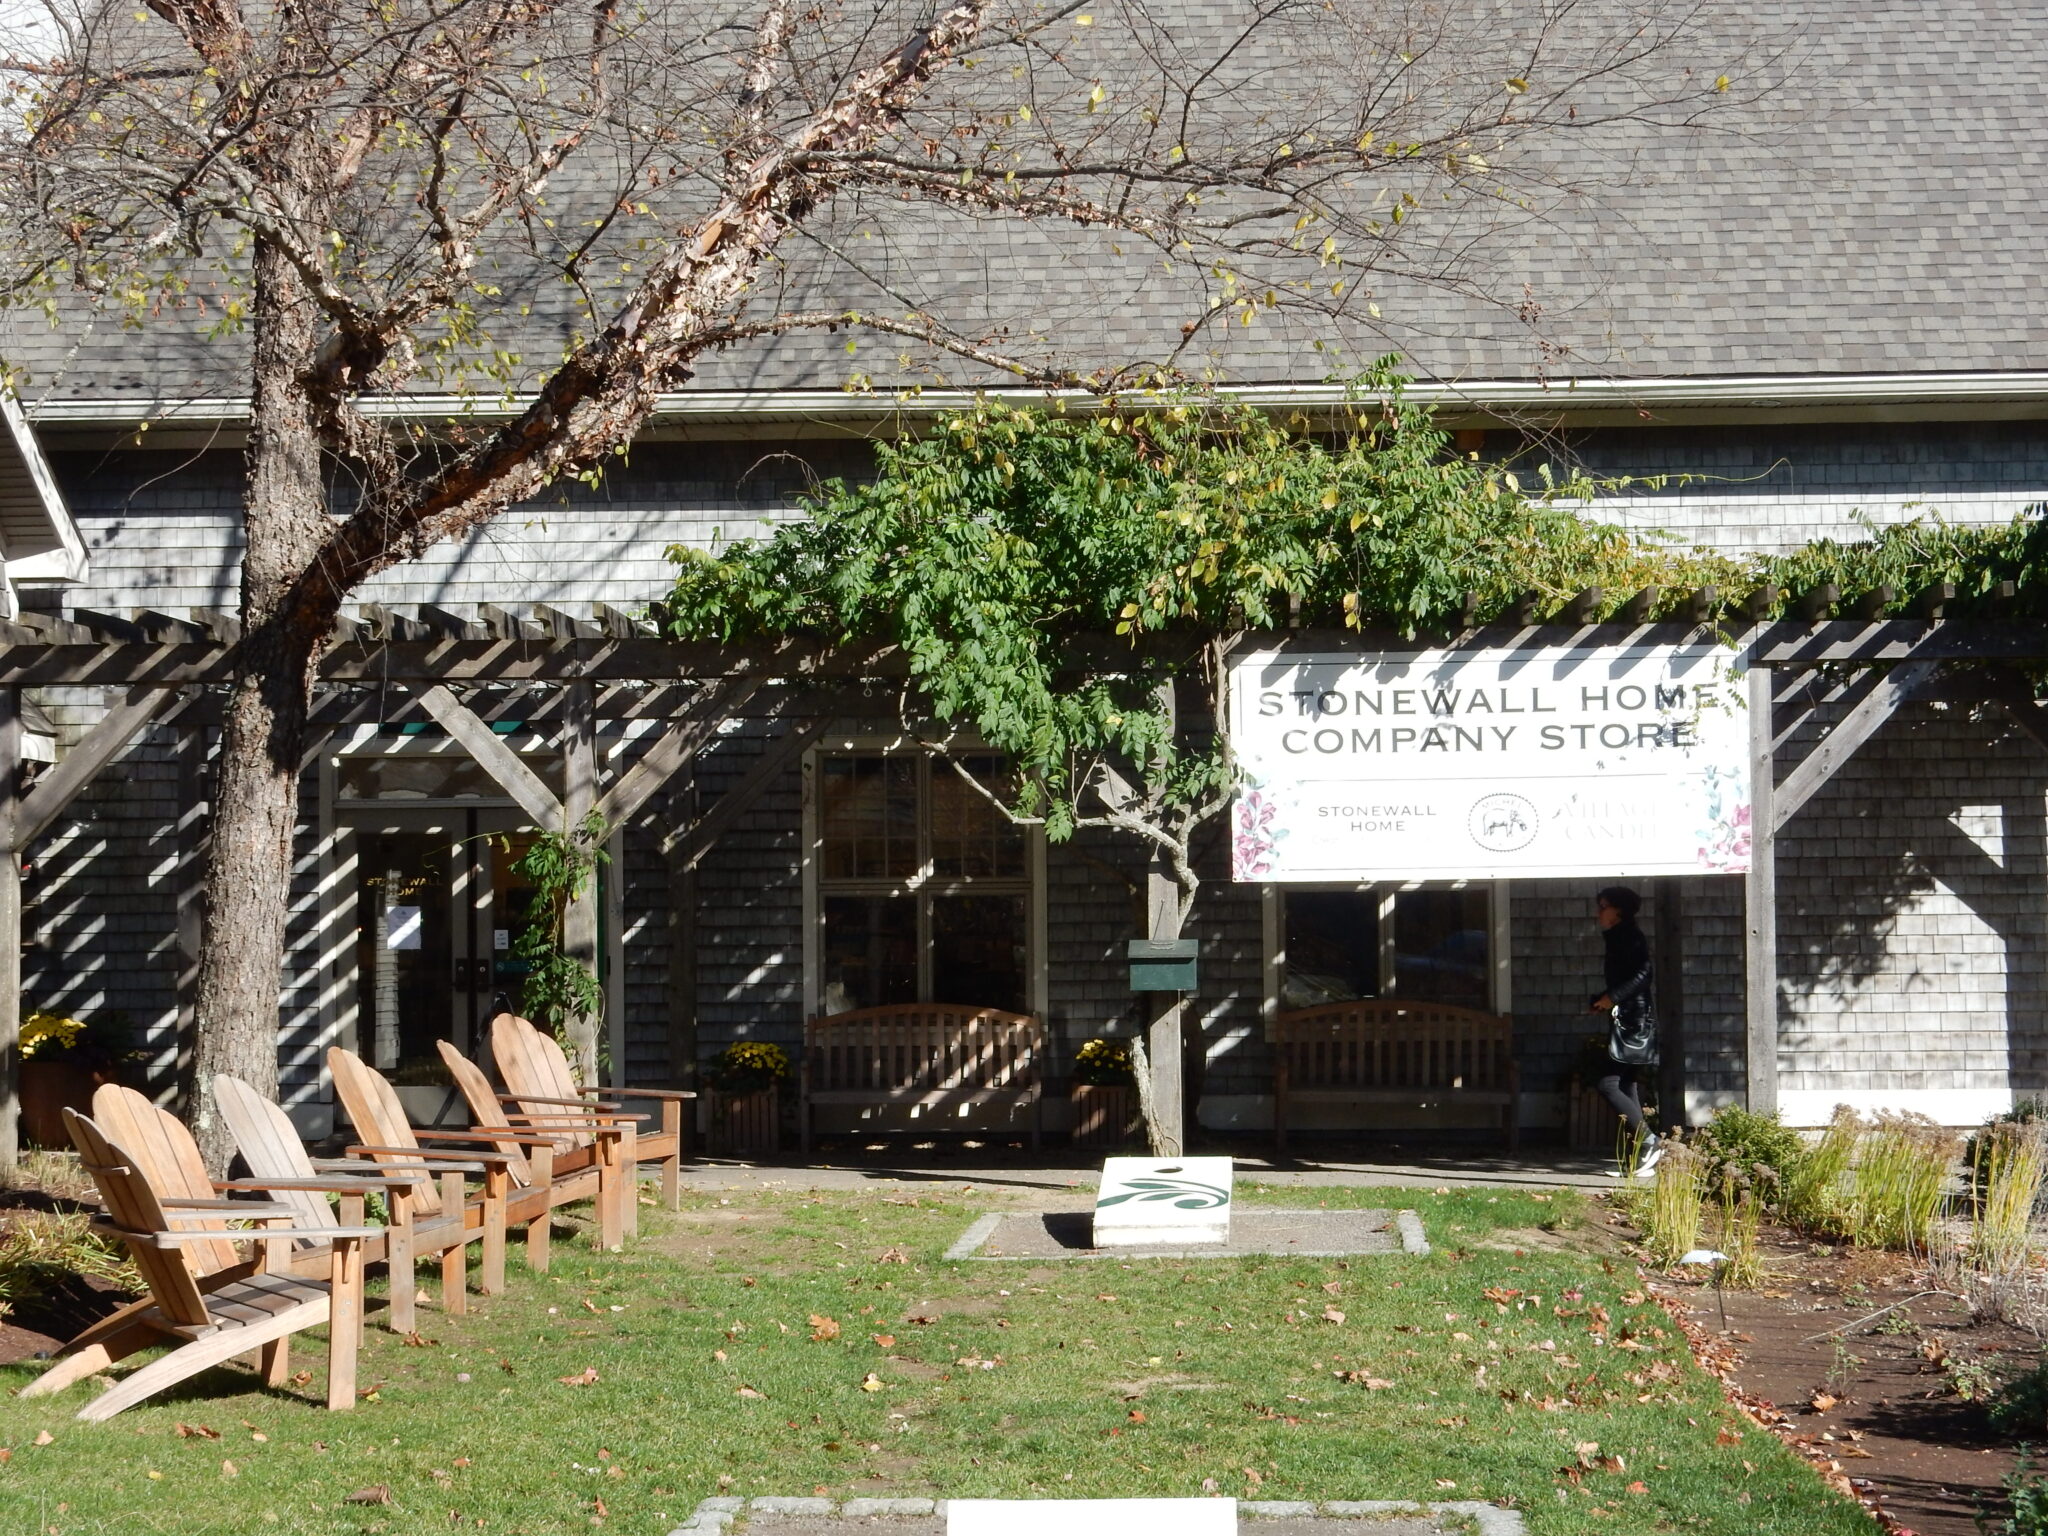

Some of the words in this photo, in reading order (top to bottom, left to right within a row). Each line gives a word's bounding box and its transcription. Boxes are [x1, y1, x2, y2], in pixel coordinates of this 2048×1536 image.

[1258, 687, 1556, 717] STONEWALL
[1581, 683, 1718, 712] HOME
[1282, 725, 1517, 754] COMPANY
[1540, 721, 1695, 750] STORE
[1318, 805, 1437, 817] STONEWALL
[1351, 820, 1405, 832] HOME
